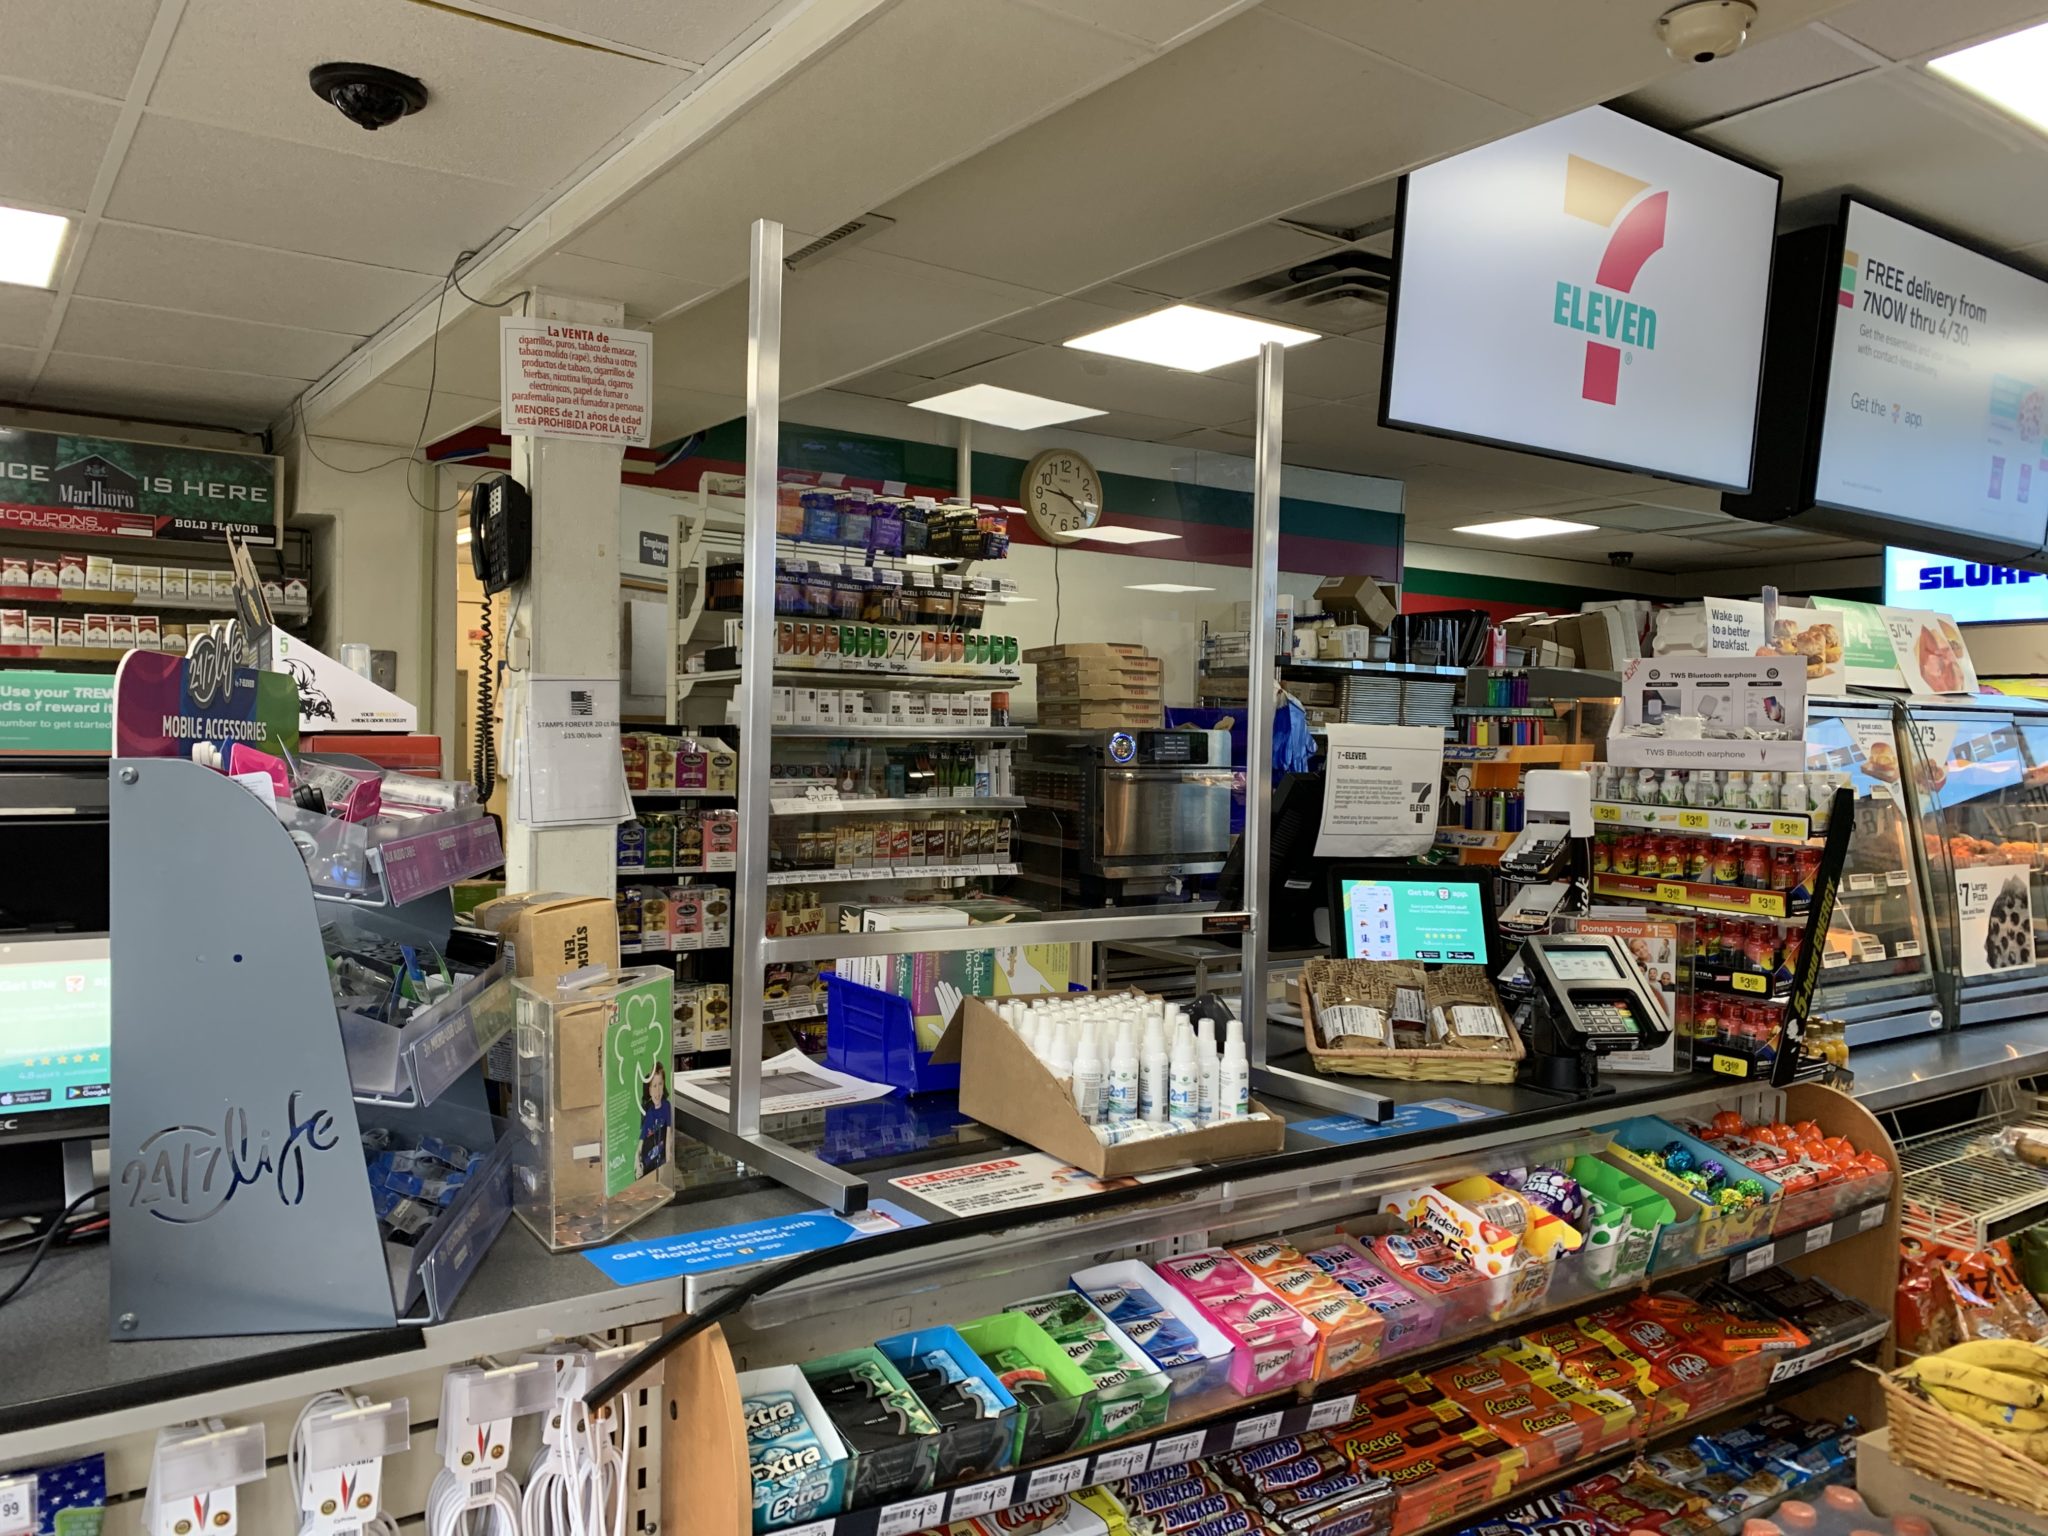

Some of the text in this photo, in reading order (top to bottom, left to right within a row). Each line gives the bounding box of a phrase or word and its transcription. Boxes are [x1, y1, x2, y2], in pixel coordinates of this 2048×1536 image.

[1865, 258, 1987, 324] FREE delivery from
[1553, 280, 1657, 350] ELEVEN
[1862, 289, 1907, 324] 7NOW
[1909, 307, 1936, 335] thru
[547, 326, 609, 343] La VENTA de
[518, 346, 543, 357] tabaco
[578, 342, 600, 352] tabaco
[602, 344, 610, 353] de
[521, 359, 557, 370] productos
[557, 361, 567, 370] de
[1851, 392, 1870, 413] Get
[1870, 399, 1886, 417] the
[514, 404, 560, 417] MENORES
[561, 408, 573, 418] de
[574, 409, 585, 420] 21
[608, 413, 620, 423] de
[620, 415, 642, 426] edad
[537, 416, 588, 430] PROHIBIDA
[589, 421, 608, 432] POR
[609, 424, 621, 433] LA
[1049, 462, 1058, 475] 11
[1060, 459, 1072, 474] 12
[1075, 466, 1080, 479] 1
[1041, 472, 1052, 486] 10
[1082, 478, 1090, 492] 2
[59, 480, 135, 509] Marlboro
[144, 476, 268, 503] IS HERE
[1036, 486, 1044, 499] 9
[1085, 492, 1093, 504] 3
[5, 509, 98, 526] COUPONS
[1040, 502, 1048, 516] 8
[174, 518, 209, 530] BOLD
[1049, 513, 1057, 526] 7
[1060, 518, 1068, 531] 6
[1072, 516, 1080, 529] 5
[652, 550, 667, 563] Only
[1711, 608, 1744, 625] Wake up
[1712, 624, 1751, 638] to a better
[279, 636, 289, 654] 5
[1712, 637, 1750, 652] breakfast.
[1670, 671, 1757, 680] TWS Bluetooth earphone
[0, 685, 31, 698] Use
[34, 688, 70, 700] your
[25, 700, 42, 712] of
[44, 702, 100, 714] reward
[40, 719, 51, 729] to
[53, 720, 71, 730] get
[162, 715, 267, 742] MOBILE ACCESSORIES
[537, 721, 564, 729] STAMPS
[564, 721, 594, 729] FOREVER
[1409, 803, 1431, 812] ELEVEN
[1407, 889, 1422, 897] Get
[1422, 889, 1436, 897] the
[1971, 883, 1988, 893] Large
[1972, 891, 1989, 902] Pizza
[1812, 878, 1837, 952] ENERGY
[1581, 925, 1614, 935] Donate
[1615, 925, 1643, 936] Today
[576, 925, 590, 969] STACK
[903, 1174, 930, 1187] WE
[932, 1166, 986, 1181] CHECK
[1527, 1172, 1550, 1184] ICE
[1520, 1182, 1567, 1201] CUBES
[611, 1220, 816, 1261] Get in and out faster with
[651, 1231, 796, 1261] Mobile Checkout.
[686, 1255, 711, 1265] Get
[714, 1251, 734, 1260] the
[1244, 1243, 1281, 1265] Trident
[1178, 1256, 1221, 1280] Trident
[1274, 1270, 1313, 1294] Trident
[1309, 1298, 1348, 1322] Trident
[1453, 1368, 1501, 1390] Reese's
[1484, 1393, 1532, 1416] Reese's
[1521, 1411, 1572, 1433] Reese's
[750, 1445, 821, 1481] Extra
[1242, 1436, 1300, 1474] SNICKERS
[772, 1482, 829, 1518] Extra
[1144, 1478, 1203, 1512] SNICKERS
[1168, 1494, 1227, 1529] SNICKERS
